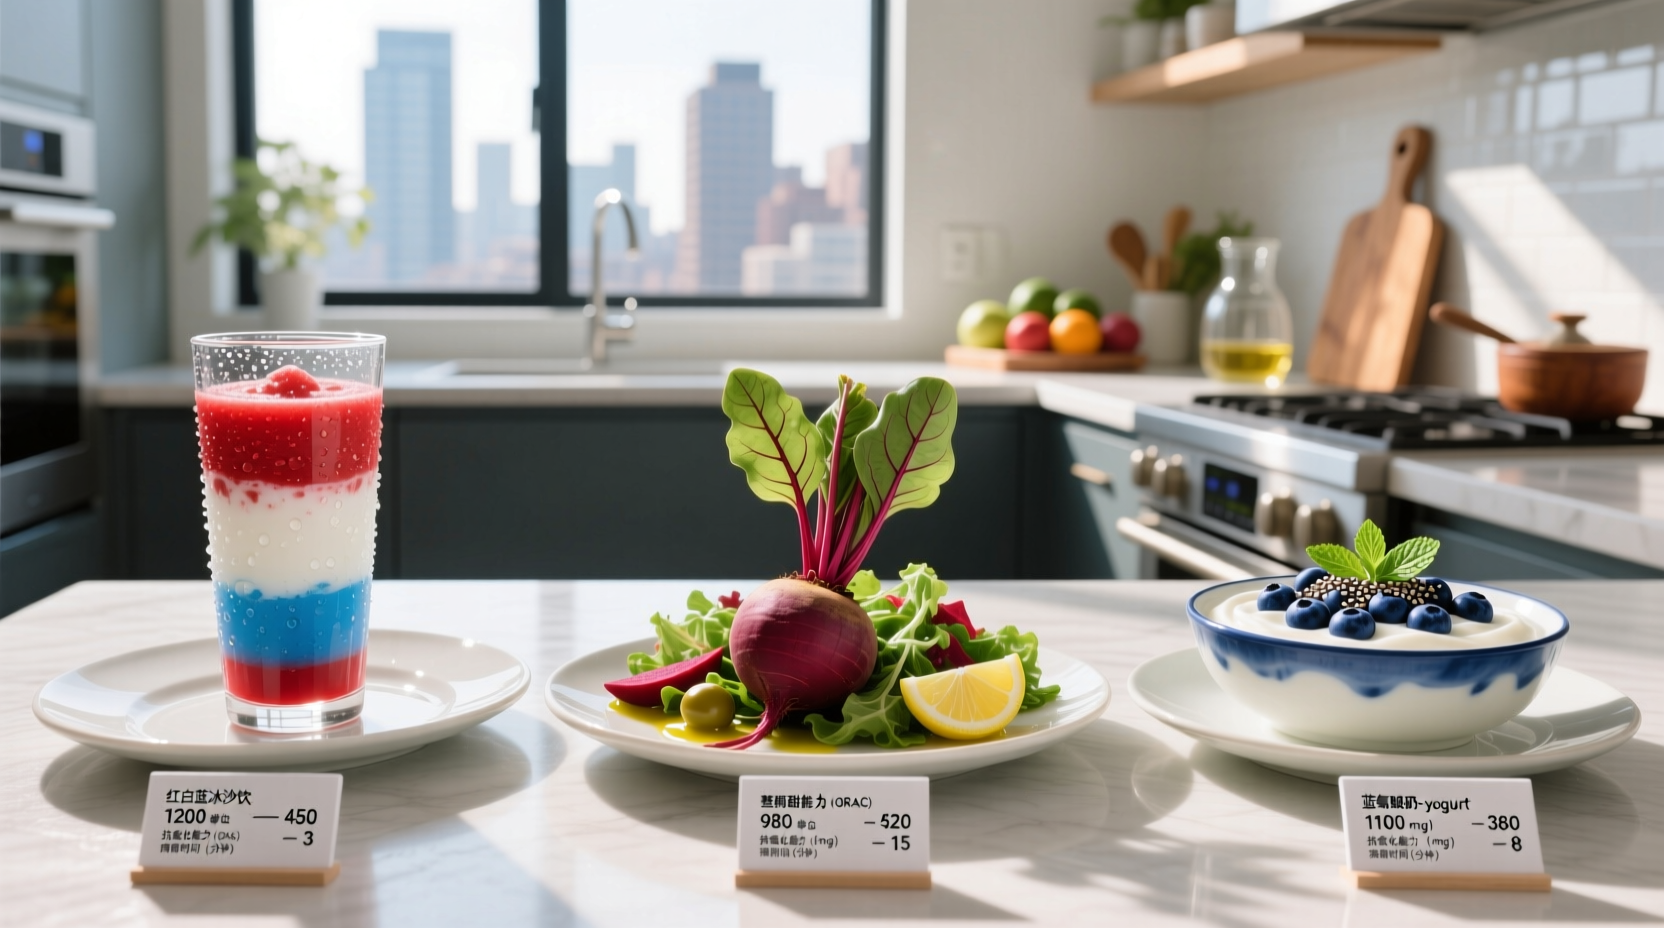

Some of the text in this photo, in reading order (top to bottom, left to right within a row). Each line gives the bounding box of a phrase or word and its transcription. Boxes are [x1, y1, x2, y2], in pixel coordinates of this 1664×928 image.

[831, 796, 872, 810] (ORAC)
[165, 808, 207, 824] 1200
[760, 813, 793, 829] 980
[1365, 815, 1405, 830] 1100
